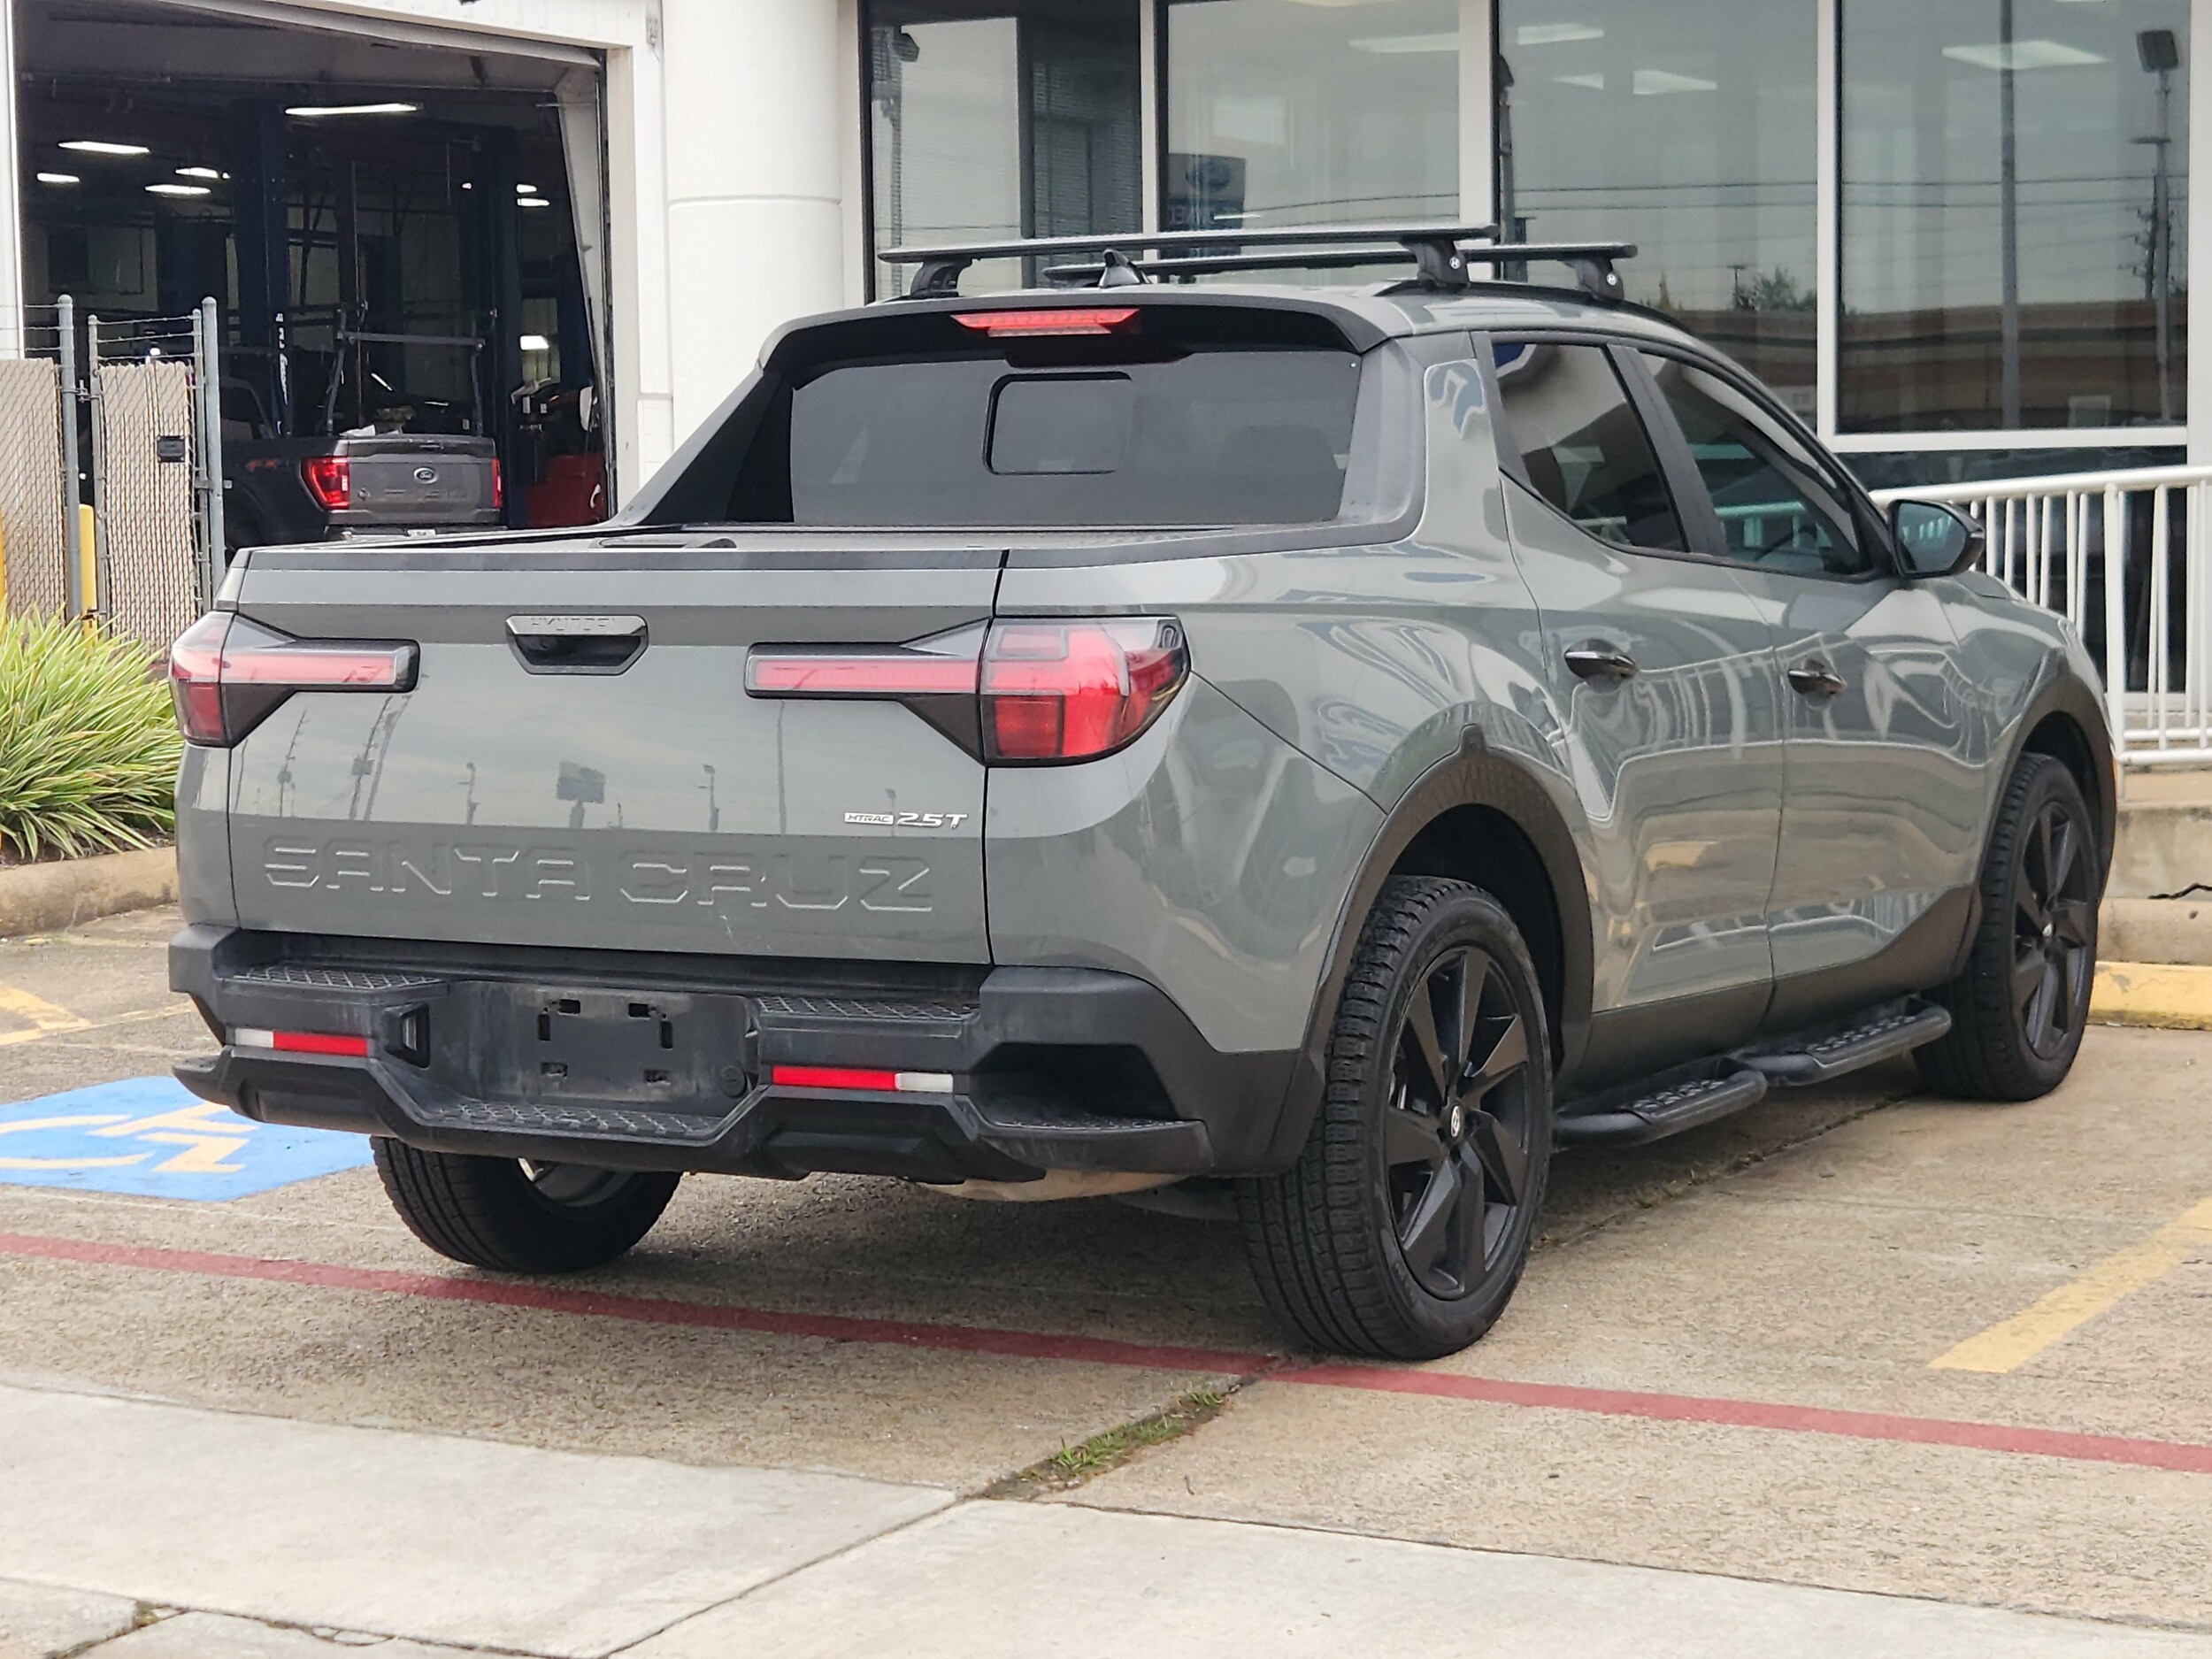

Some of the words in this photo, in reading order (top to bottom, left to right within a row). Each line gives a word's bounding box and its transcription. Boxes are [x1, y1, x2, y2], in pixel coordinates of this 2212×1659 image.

[847, 813, 893, 824] HTRAC
[264, 835, 591, 902] SANTA
[619, 848, 934, 912] CRUZ
